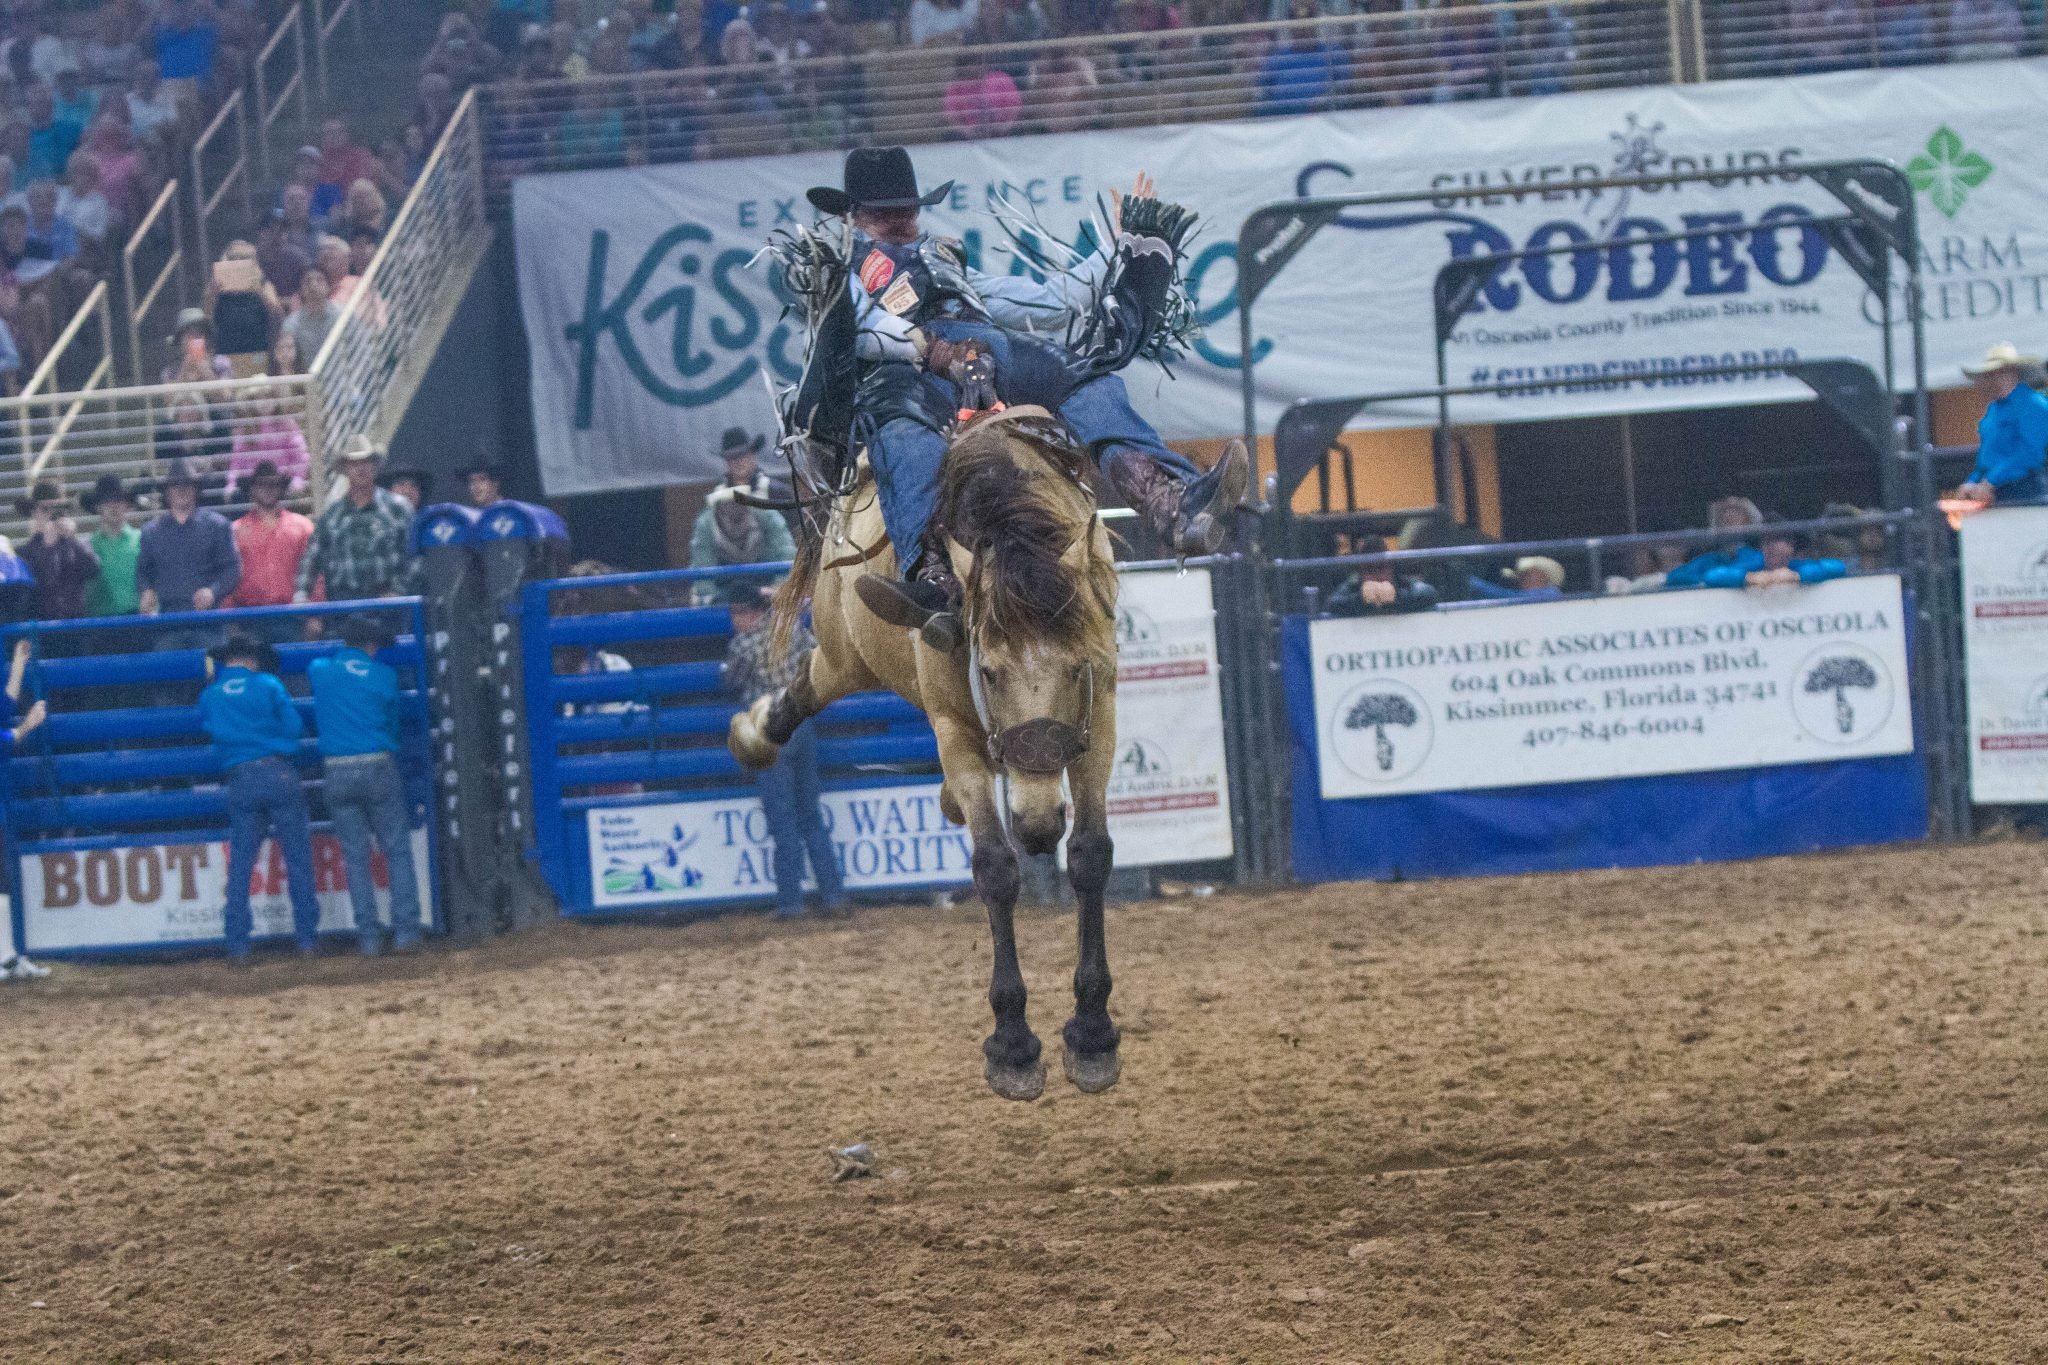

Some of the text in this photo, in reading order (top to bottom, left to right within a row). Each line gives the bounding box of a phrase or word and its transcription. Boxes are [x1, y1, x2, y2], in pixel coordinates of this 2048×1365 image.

[1431, 147, 1804, 208] SILVER SPURS
[1445, 204, 1830, 312] RODEO
[1917, 232, 2023, 274] ARM
[1557, 316, 1626, 339] County
[1630, 307, 1718, 330] Tradition
[1723, 302, 1775, 317] Since
[1325, 609, 1889, 673] ORTHOPAEDIC ASSOCIATES OF OSCEOLA
[1451, 650, 1768, 693] 604 Oak Commons Blvd.
[1445, 681, 1778, 722] Kissimmee, Florida 34741
[1522, 716, 1704, 750] 407-846-6004
[714, 795, 970, 848] TO WAT
[41, 845, 209, 908] BOOT
[734, 834, 973, 886] AUORITY
